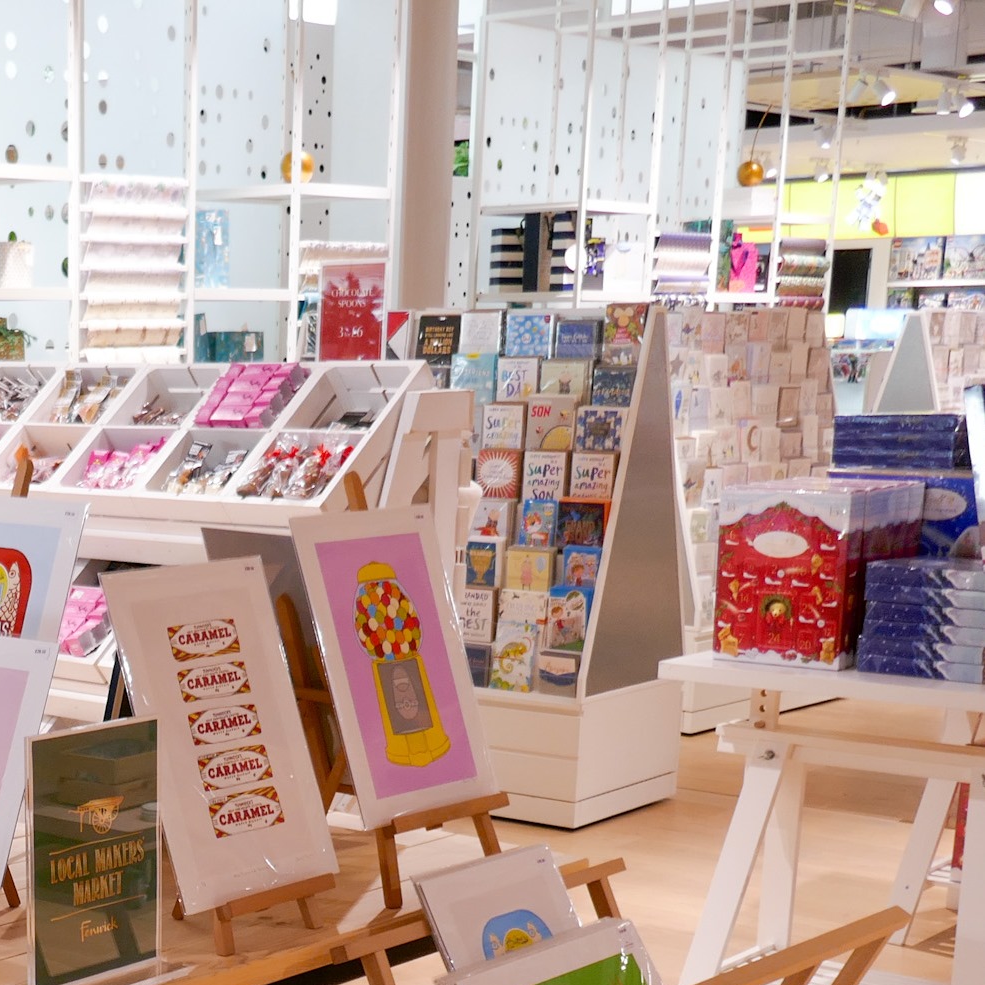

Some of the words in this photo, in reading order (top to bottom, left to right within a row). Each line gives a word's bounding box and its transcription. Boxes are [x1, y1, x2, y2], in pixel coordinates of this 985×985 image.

[331, 288, 374, 298] CHOCOLATE
[337, 299, 366, 308] SPOONS
[531, 405, 552, 418] SON
[527, 463, 563, 478] Super
[575, 465, 611, 481] Super
[526, 478, 561, 490] amazing
[574, 481, 609, 492] amazing
[532, 489, 555, 501] SON
[465, 608, 480, 617] the
[178, 627, 232, 645] CARAMEL
[768, 633, 782, 644] 24
[799, 640, 812, 650] 20
[187, 671, 241, 690] CARAMEL
[197, 714, 252, 735] CARAMEL
[208, 758, 263, 779] CARAMEL
[218, 804, 275, 826] CARAMEL
[50, 852, 91, 885] LOCAL
[94, 836, 145, 873] MAKERS'
[73, 870, 124, 907] MARKET
[80, 917, 119, 943] Fenwick
